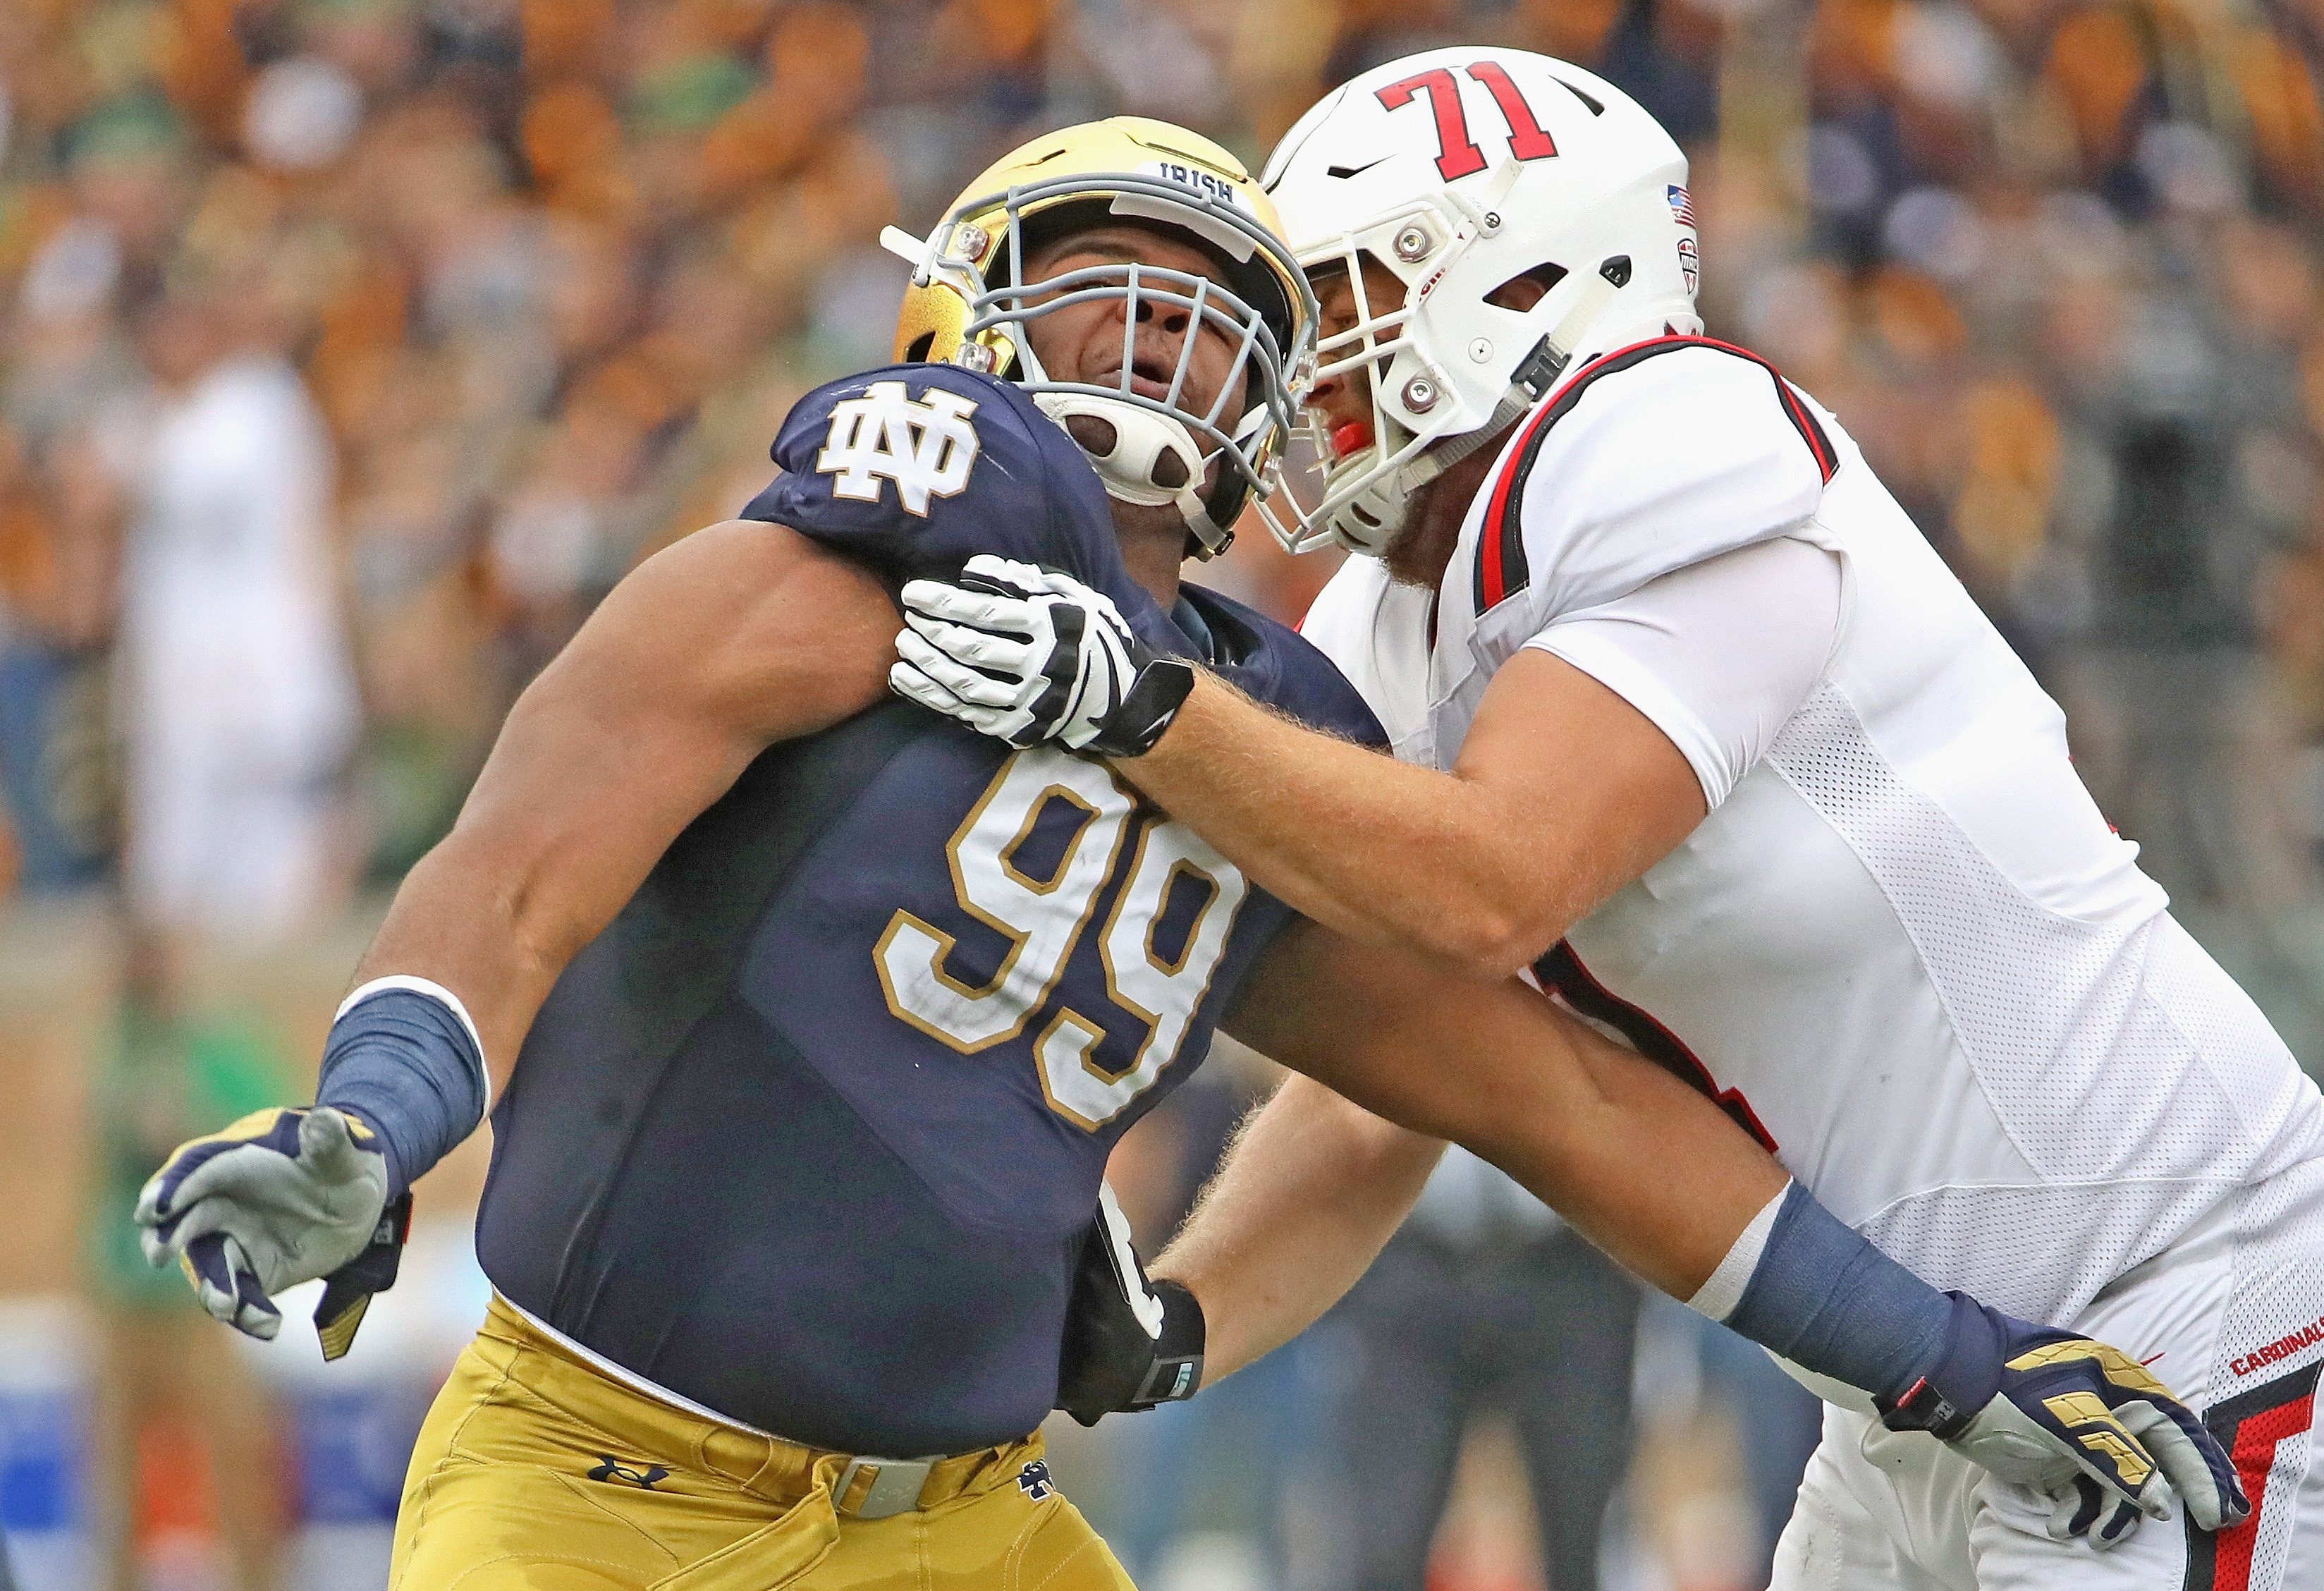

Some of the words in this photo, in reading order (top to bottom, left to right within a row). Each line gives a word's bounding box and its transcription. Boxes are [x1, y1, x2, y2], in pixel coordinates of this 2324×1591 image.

[1160, 162, 1234, 204] IRISH
[1374, 60, 1560, 184] 71
[816, 380, 981, 518] ND
[872, 748, 1249, 1133] 99
